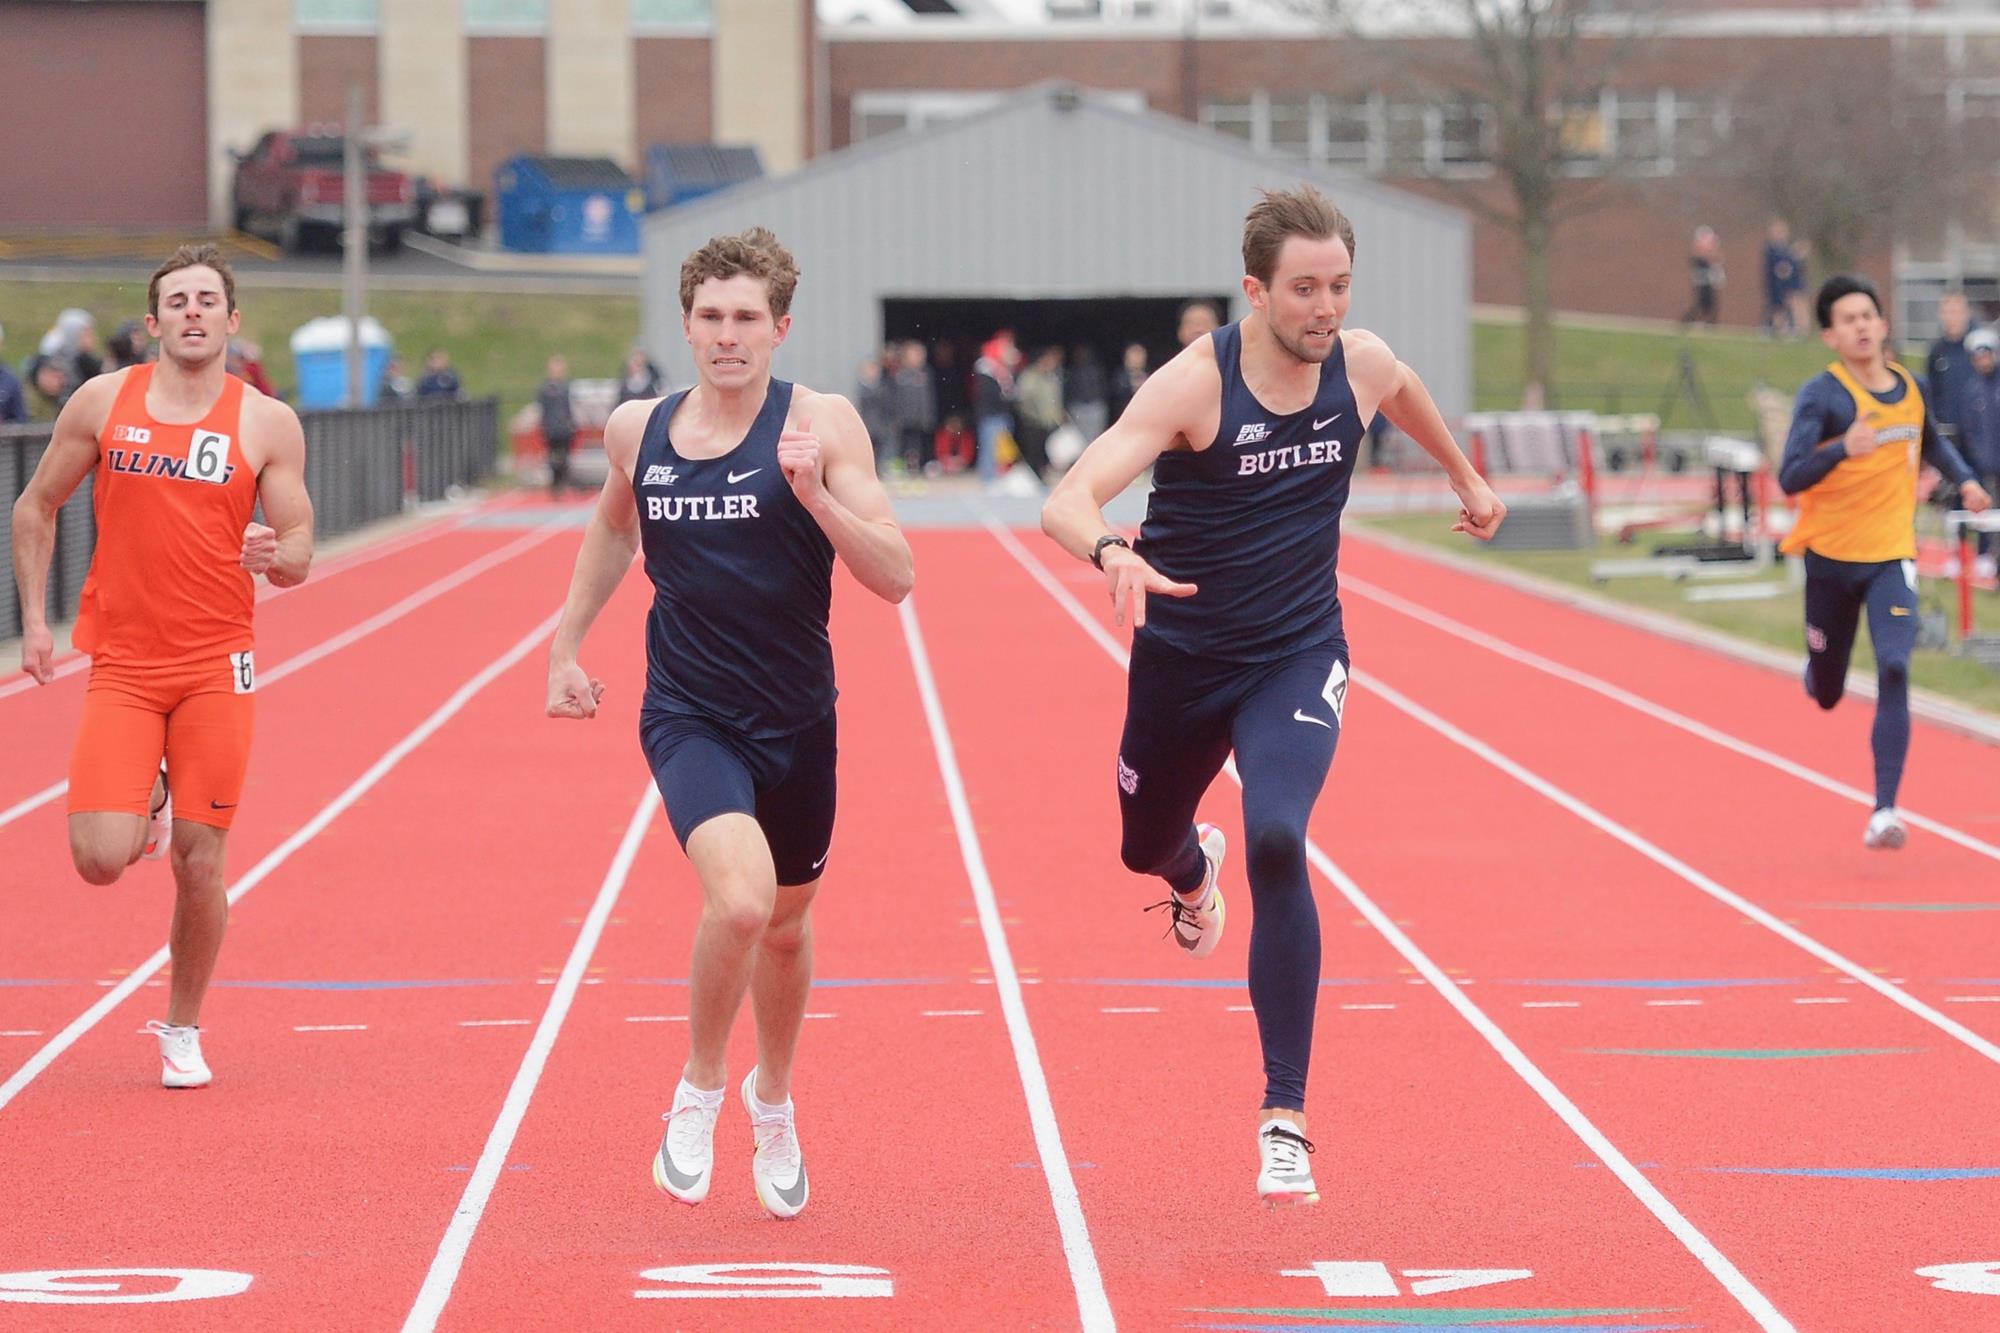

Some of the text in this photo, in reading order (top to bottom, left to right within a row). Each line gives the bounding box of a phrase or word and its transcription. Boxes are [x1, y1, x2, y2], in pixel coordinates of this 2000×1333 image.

[1235, 431, 1272, 442] EAST
[1240, 423, 1266, 433] BIG
[195, 435, 220, 477] 6
[1237, 440, 1342, 475] BUTLER
[643, 473, 680, 484] EAST
[646, 465, 674, 475] BIG
[646, 495, 760, 521] BUTLER
[1280, 1261, 1534, 1298] 4
